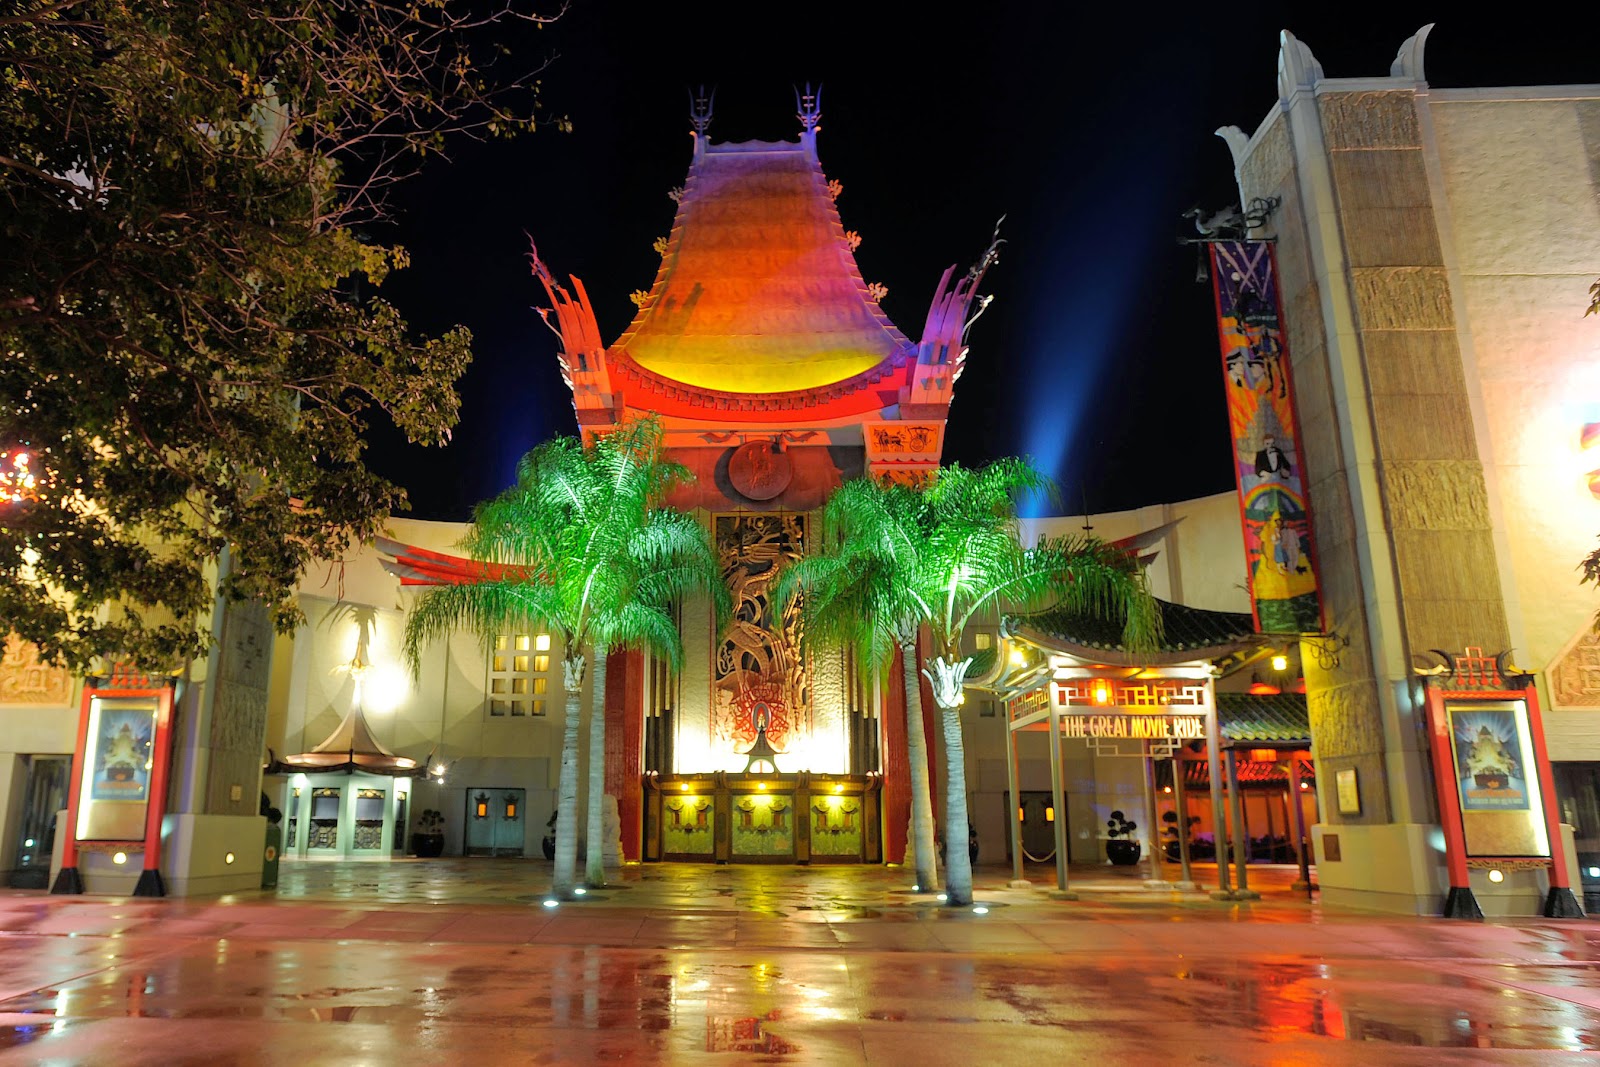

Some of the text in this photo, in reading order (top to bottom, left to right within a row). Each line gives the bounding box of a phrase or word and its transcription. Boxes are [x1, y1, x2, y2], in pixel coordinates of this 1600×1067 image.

[1064, 715, 1203, 737] THE GREAT MOVIE RIDE
